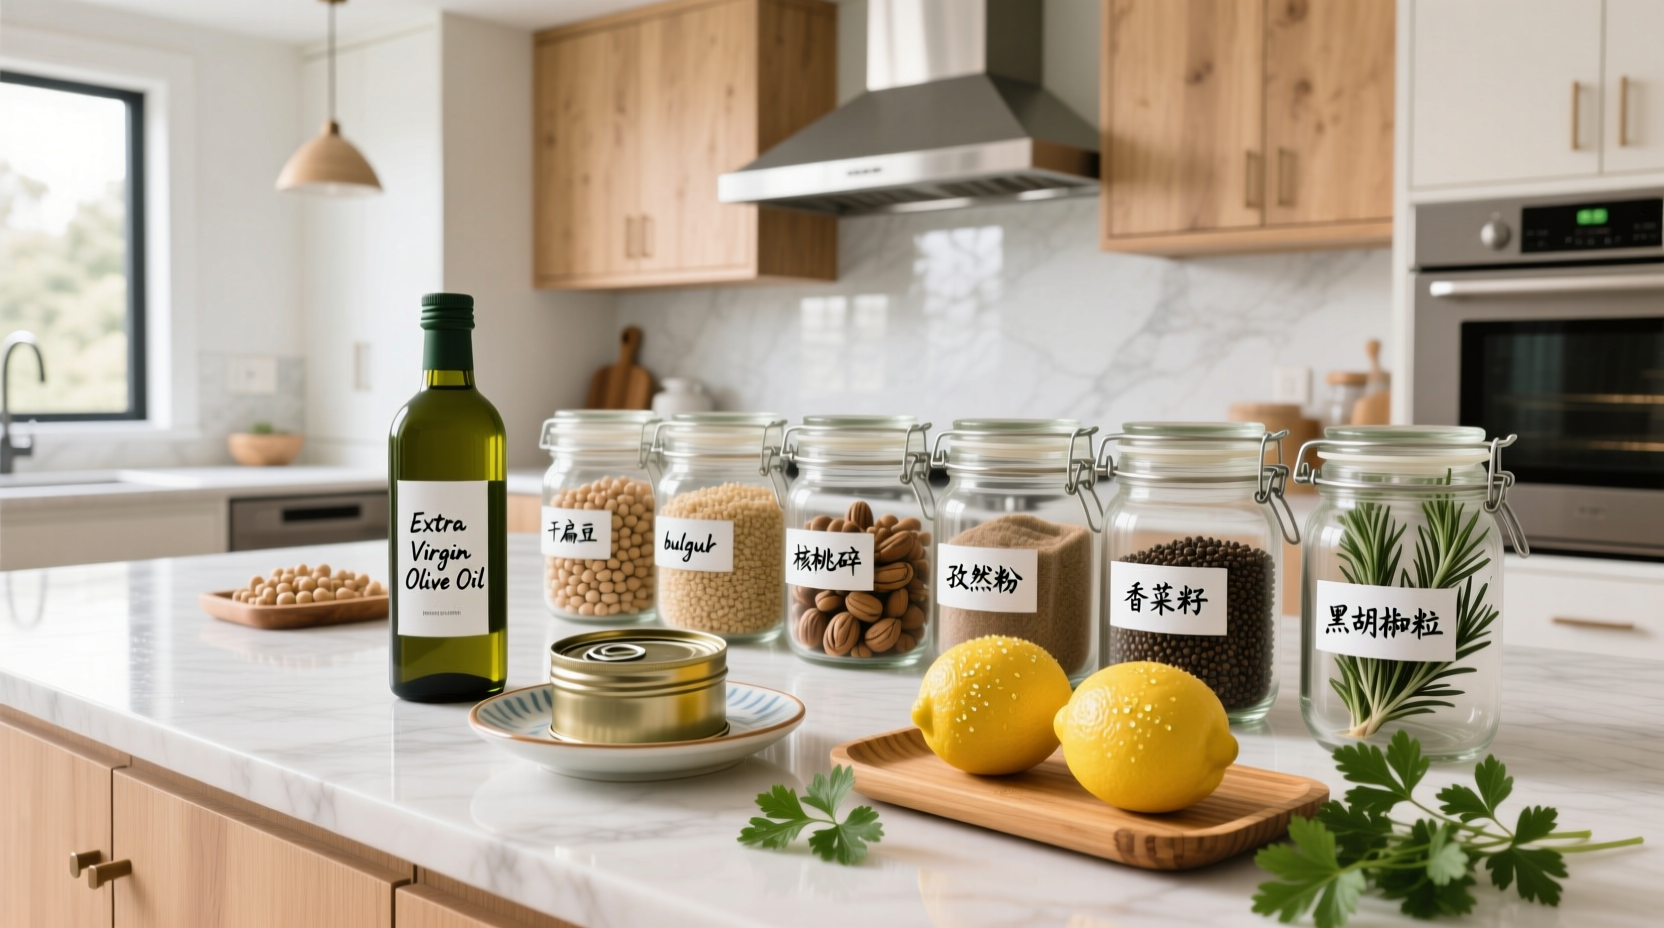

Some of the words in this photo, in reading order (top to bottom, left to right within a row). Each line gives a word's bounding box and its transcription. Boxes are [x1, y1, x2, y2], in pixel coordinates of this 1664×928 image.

[410, 511, 467, 533] Extra
[547, 519, 598, 544] 干扁豆
[411, 540, 471, 571] Virgin
[664, 530, 717, 563] bulgur
[792, 543, 862, 577] 核桃碎
[405, 567, 450, 591] Olive
[456, 566, 485, 591] Oil
[946, 563, 1024, 594] 孜然粉
[1124, 581, 1209, 616] 香菜籽
[1325, 604, 1444, 640] 黑胡椒粒
